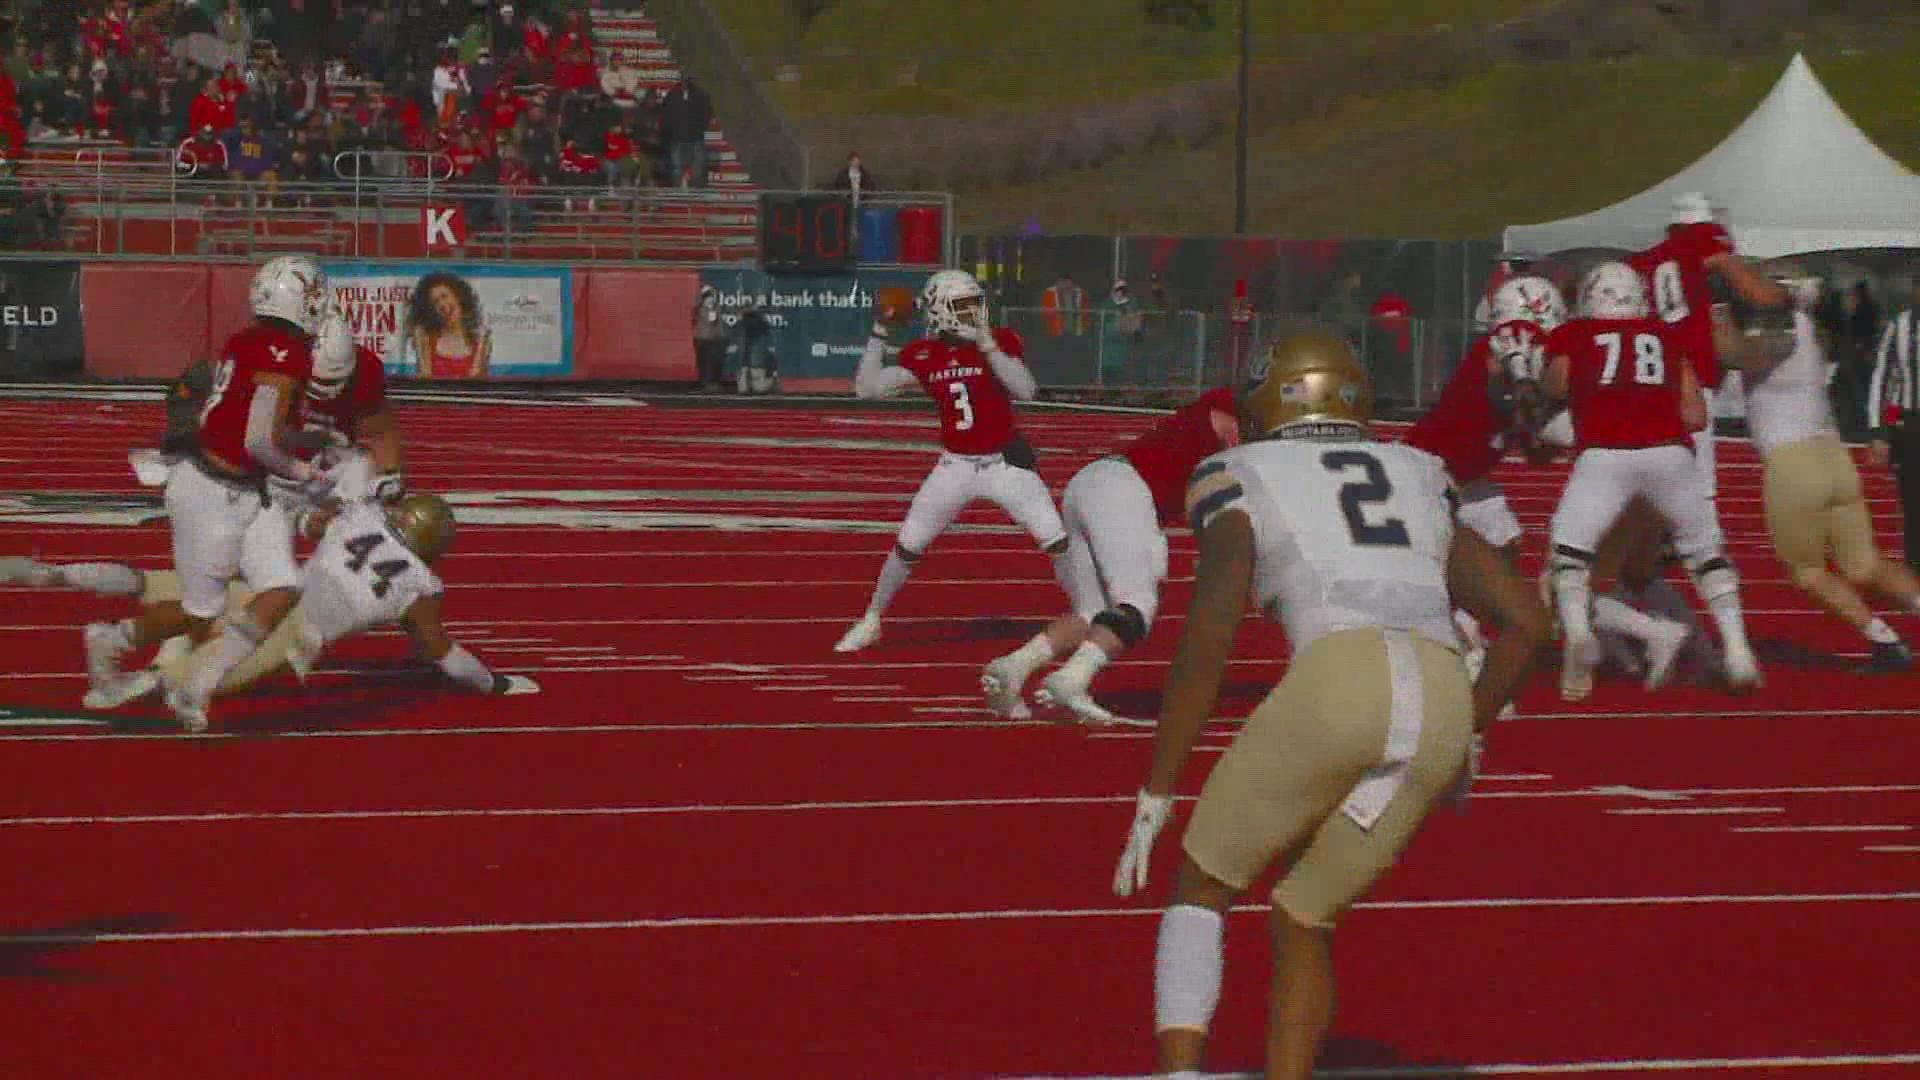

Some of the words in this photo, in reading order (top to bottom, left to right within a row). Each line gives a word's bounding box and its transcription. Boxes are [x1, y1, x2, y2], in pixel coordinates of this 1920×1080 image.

[425, 207, 458, 245] K
[773, 203, 847, 258] 40
[336, 288, 367, 302] YOU
[756, 293, 767, 306] a
[771, 289, 814, 307] bank
[819, 289, 857, 308] that
[929, 367, 984, 383] EASTERN
[1594, 332, 1665, 386] 78
[949, 382, 975, 431] 3
[1320, 450, 1411, 545] 2
[344, 533, 410, 599] 44
